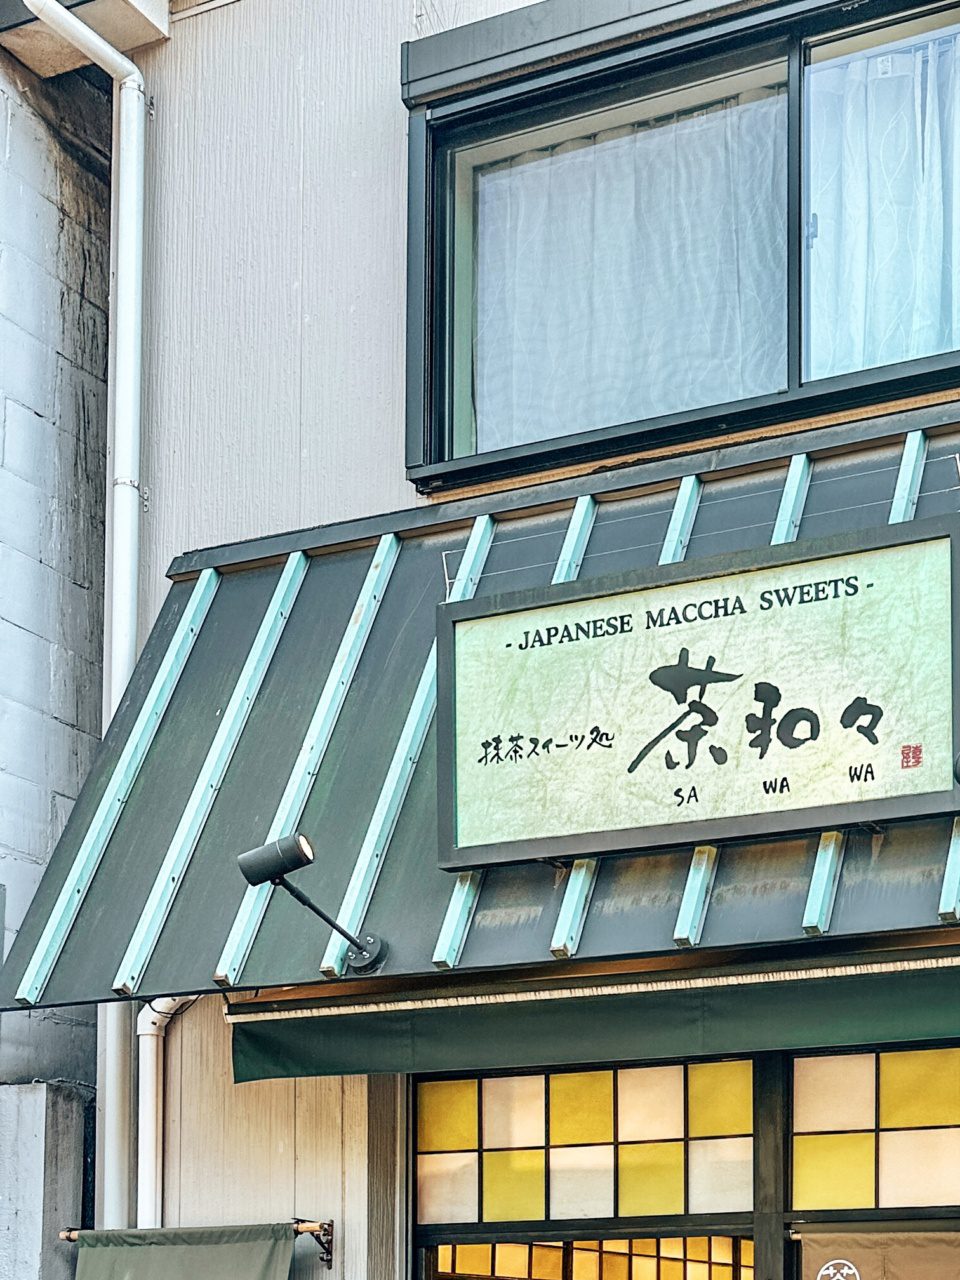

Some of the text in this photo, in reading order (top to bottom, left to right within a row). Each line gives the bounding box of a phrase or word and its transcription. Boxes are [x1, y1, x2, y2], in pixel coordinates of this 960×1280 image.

[518, 613, 633, 651] JAPANESE
[645, 596, 747, 630] MACCHA
[759, 576, 859, 611] SWEETS
[627, 647, 884, 774] 茶和々
[477, 725, 615, 766] 抹茶スイーツ処
[673, 763, 876, 807] SA WA WA
